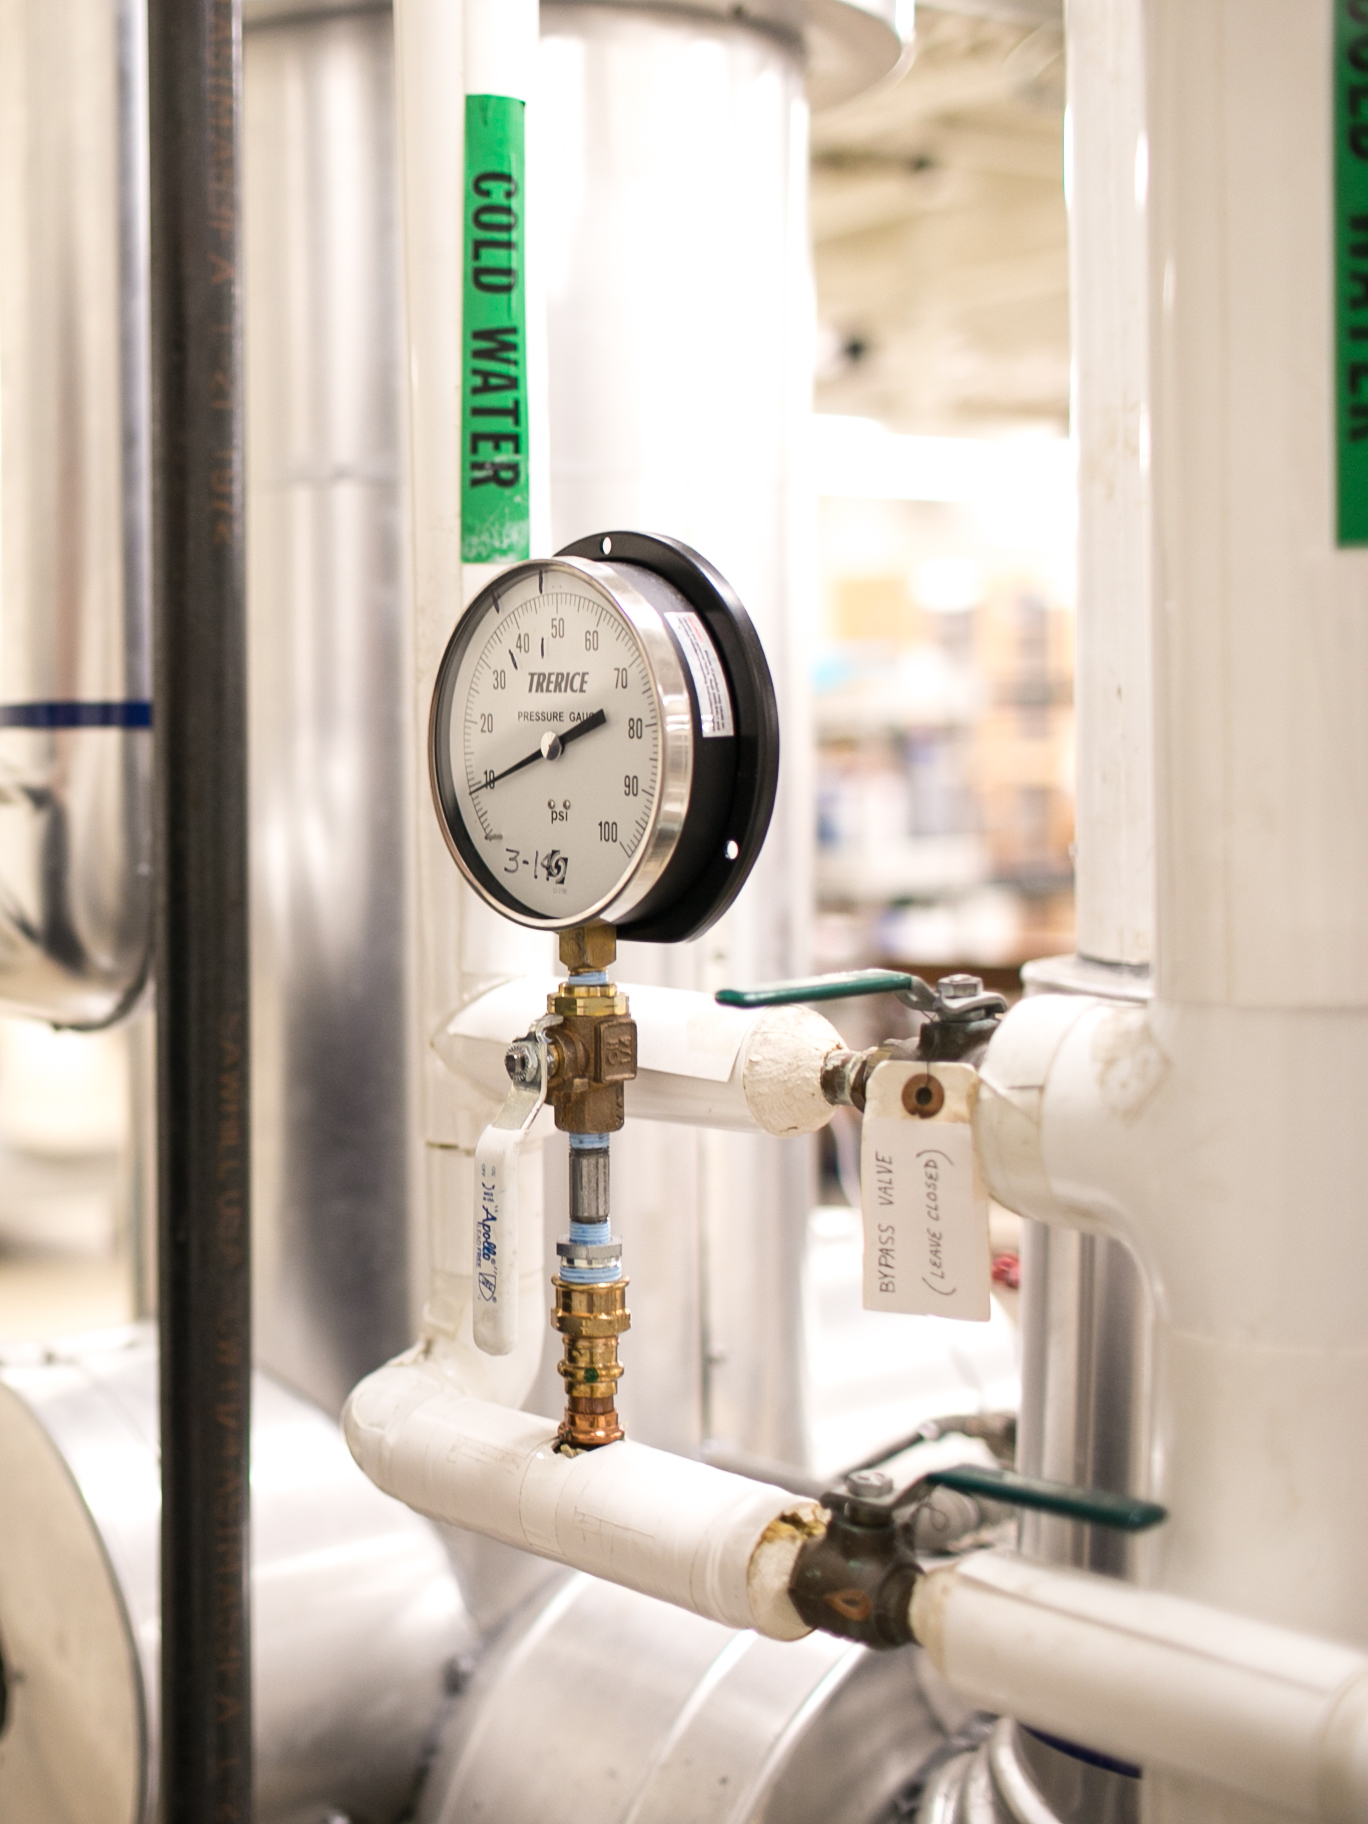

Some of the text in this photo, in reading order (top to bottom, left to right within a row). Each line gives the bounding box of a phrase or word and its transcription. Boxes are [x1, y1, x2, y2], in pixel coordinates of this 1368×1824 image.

[469, 171, 521, 490] COLD WATER
[550, 617, 565, 639] 50
[515, 632, 530, 654] 40
[584, 629, 599, 652] 60
[492, 669, 506, 690] 30
[527, 671, 590, 694] TRERICE
[613, 667, 628, 690] 70
[480, 712, 494, 734] 20
[517, 710, 565, 723] PRESSURE
[627, 717, 643, 740] 80
[483, 769, 496, 790] 10
[623, 774, 639, 797] 90
[550, 809, 569, 825] psi
[597, 820, 618, 843] 100
[874, 1150, 896, 1294] BYPASS VALVE
